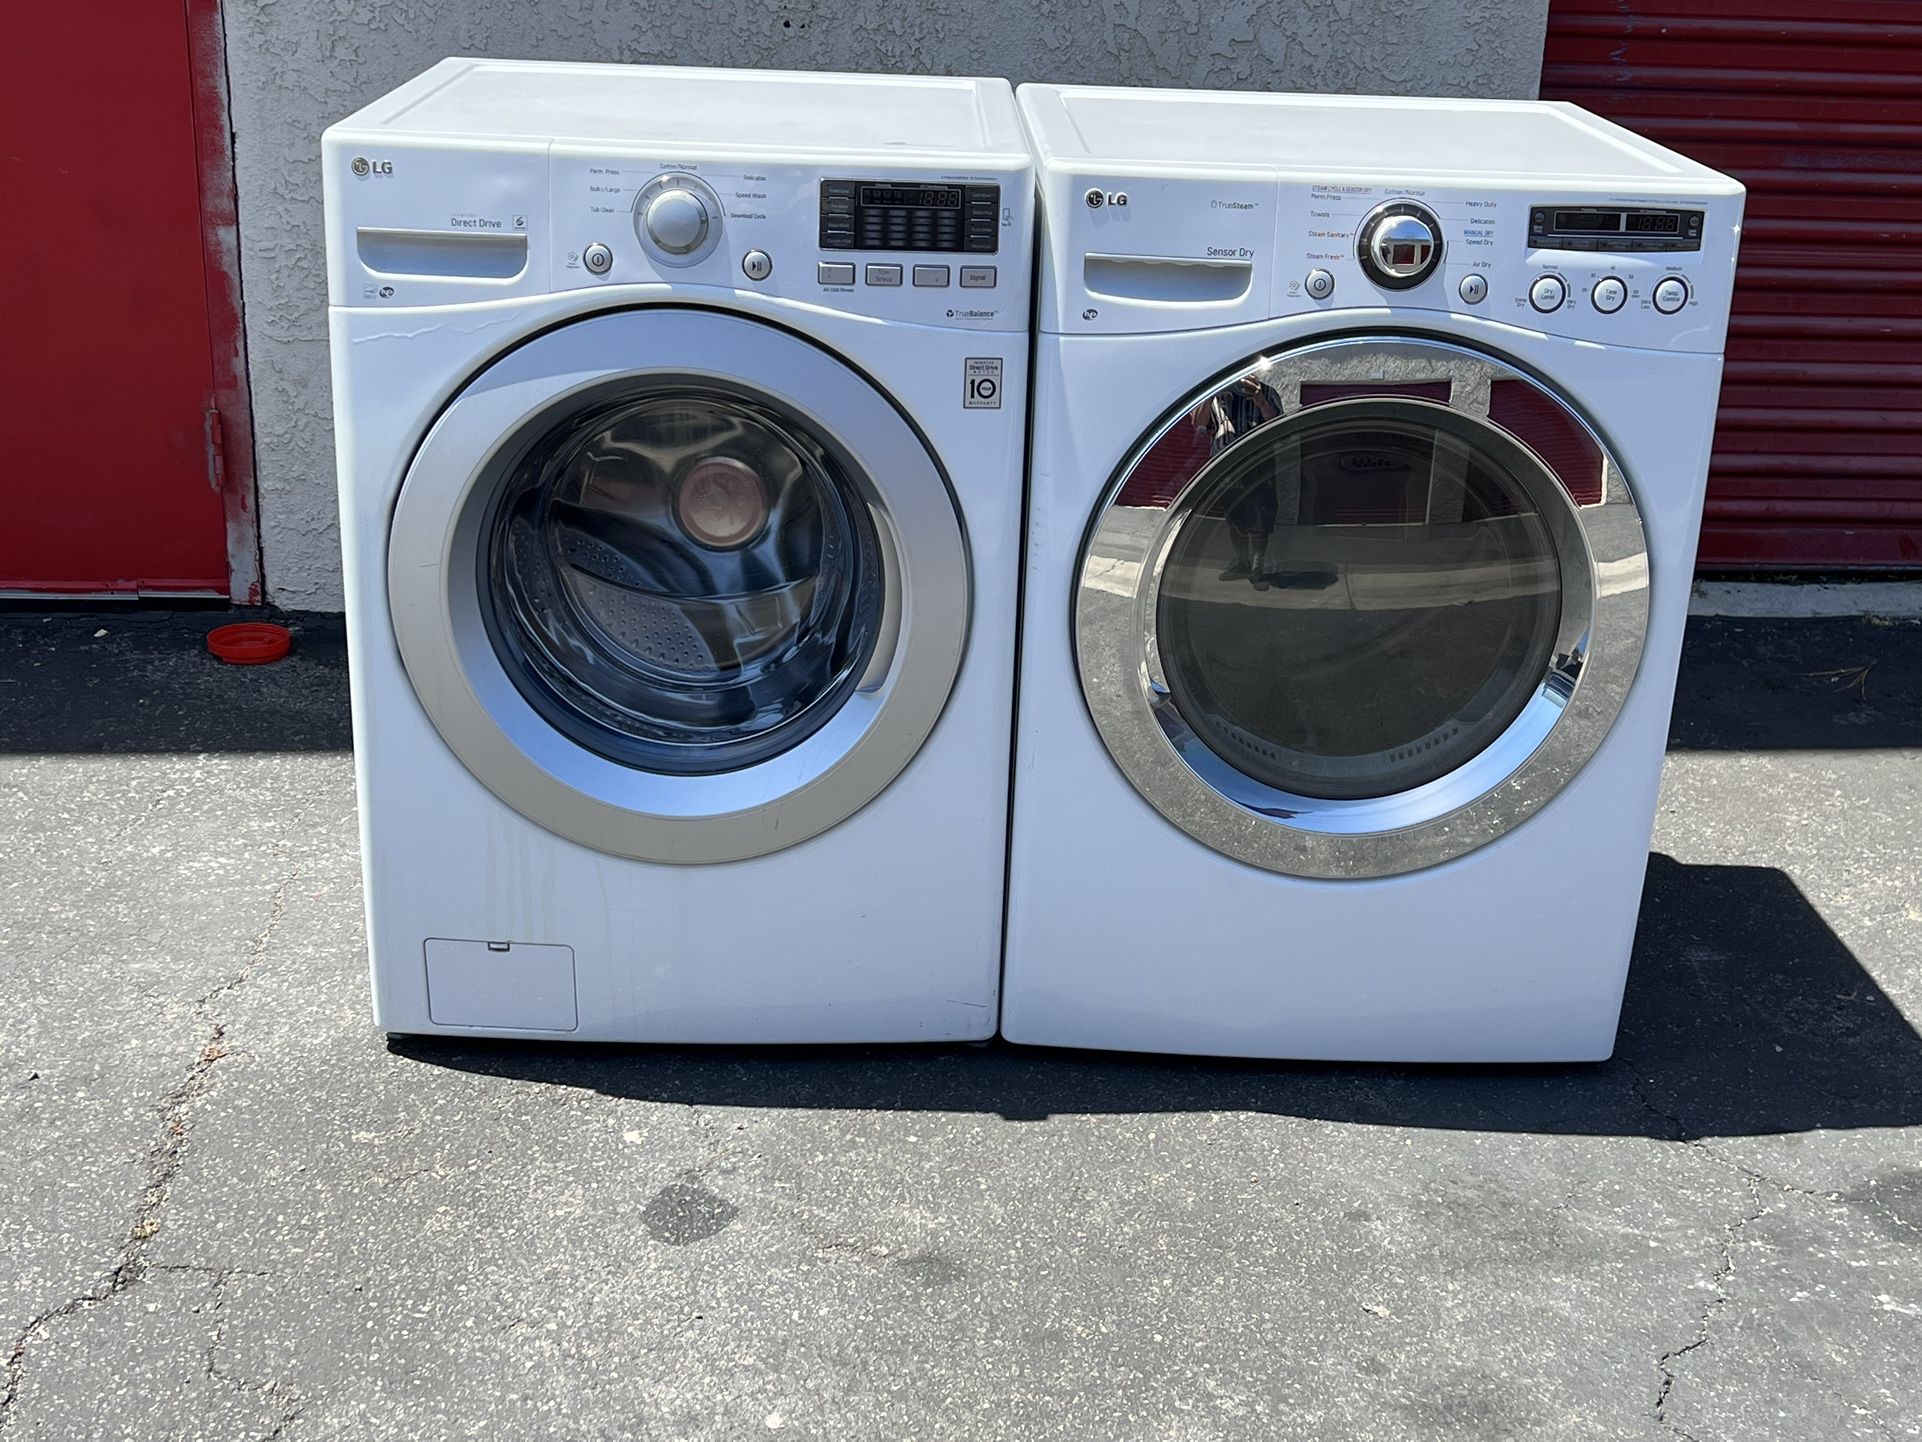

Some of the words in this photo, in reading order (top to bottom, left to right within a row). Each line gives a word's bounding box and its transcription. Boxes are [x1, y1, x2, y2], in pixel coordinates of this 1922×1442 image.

[372, 160, 393, 175] LG
[1107, 193, 1128, 207] LG
[450, 217, 477, 228] Direct
[478, 218, 502, 229] Drive
[1207, 246, 1238, 257] Sensor
[1239, 247, 1255, 258] Dry
[969, 378, 997, 400] 10
